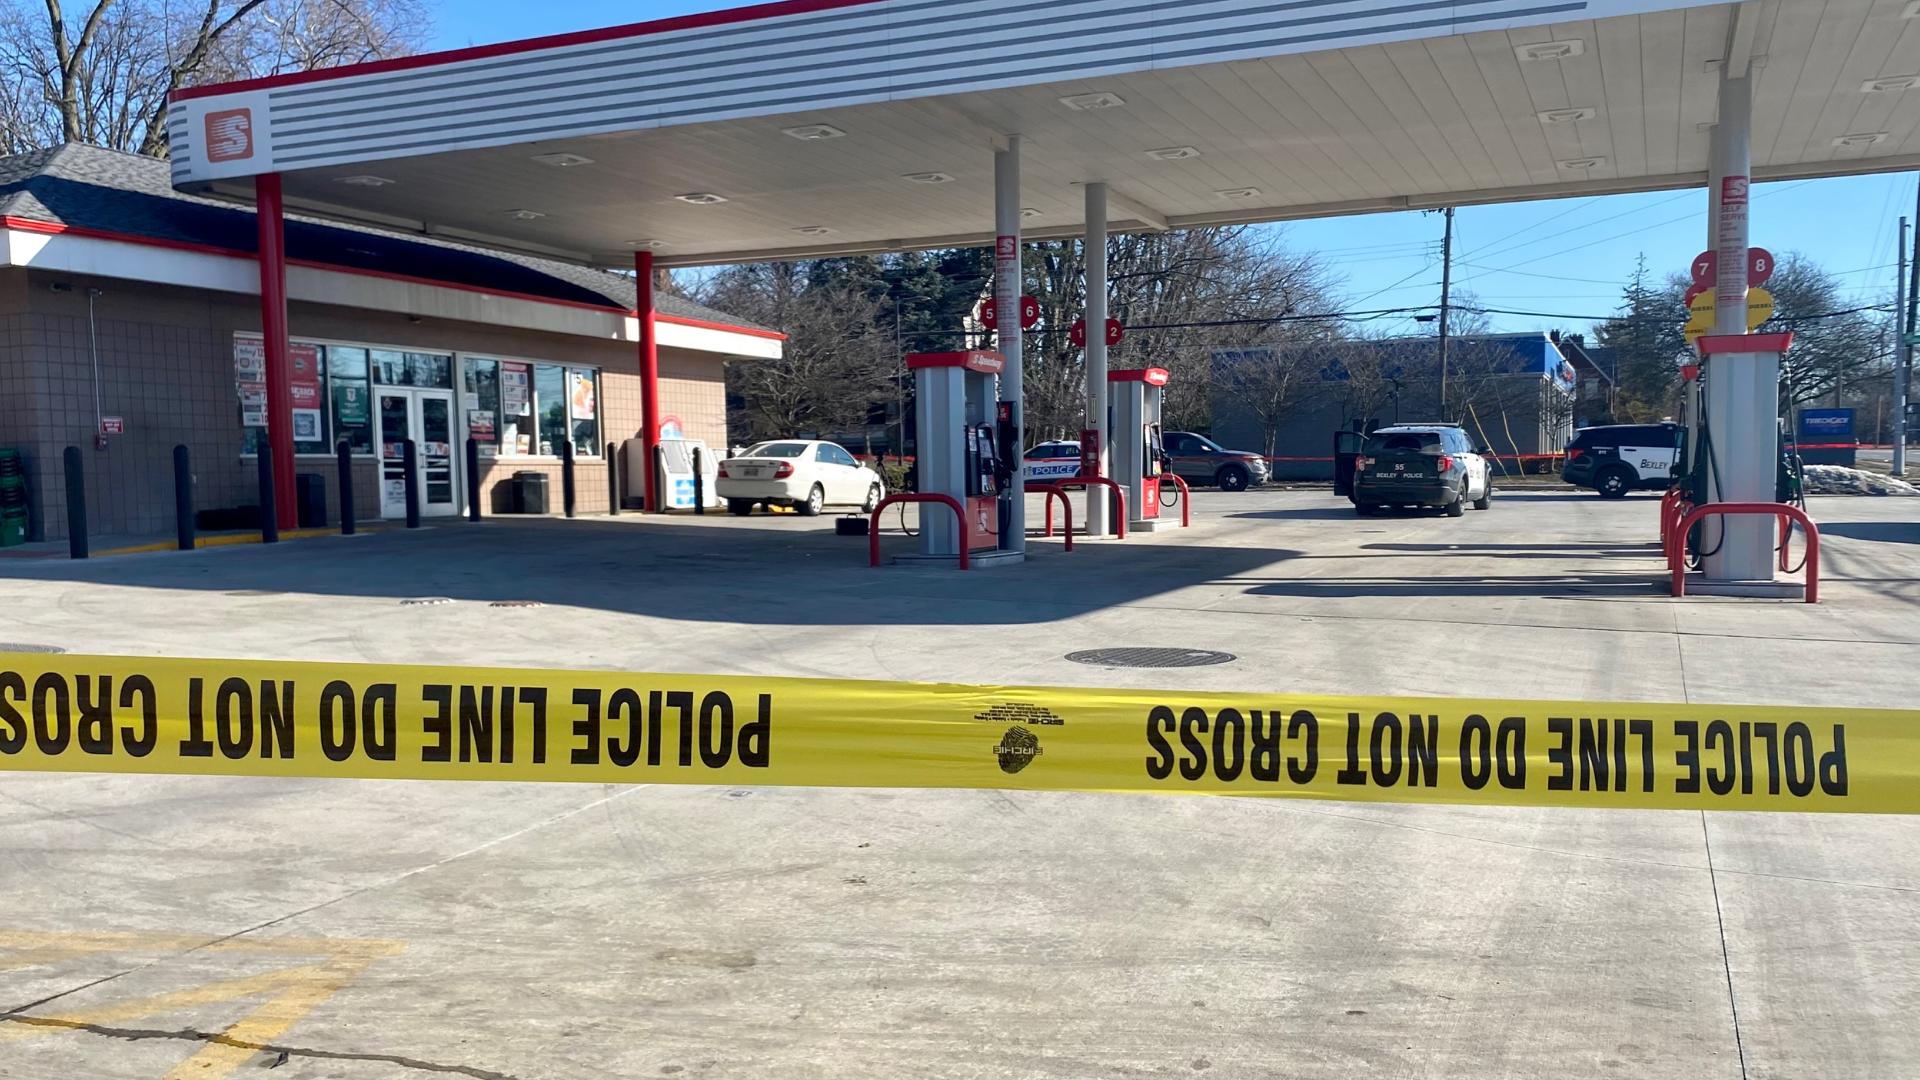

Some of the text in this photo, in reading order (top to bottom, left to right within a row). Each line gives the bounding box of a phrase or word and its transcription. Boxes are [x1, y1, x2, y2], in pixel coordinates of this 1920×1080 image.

[1699, 263, 1709, 275] 7
[1755, 259, 1766, 272] 8
[986, 309, 994, 319] 5
[1025, 306, 1034, 317] 6
[1078, 328, 1082, 338] 1
[1110, 327, 1117, 336] 2
[1035, 465, 1073, 475] POLICE
[179, 677, 295, 760] NOT
[319, 680, 397, 762] DO
[421, 684, 548, 764] LINE
[571, 687, 771, 768] POLICE
[1146, 705, 1849, 798] POLICE LINE DO NOT CROSS
